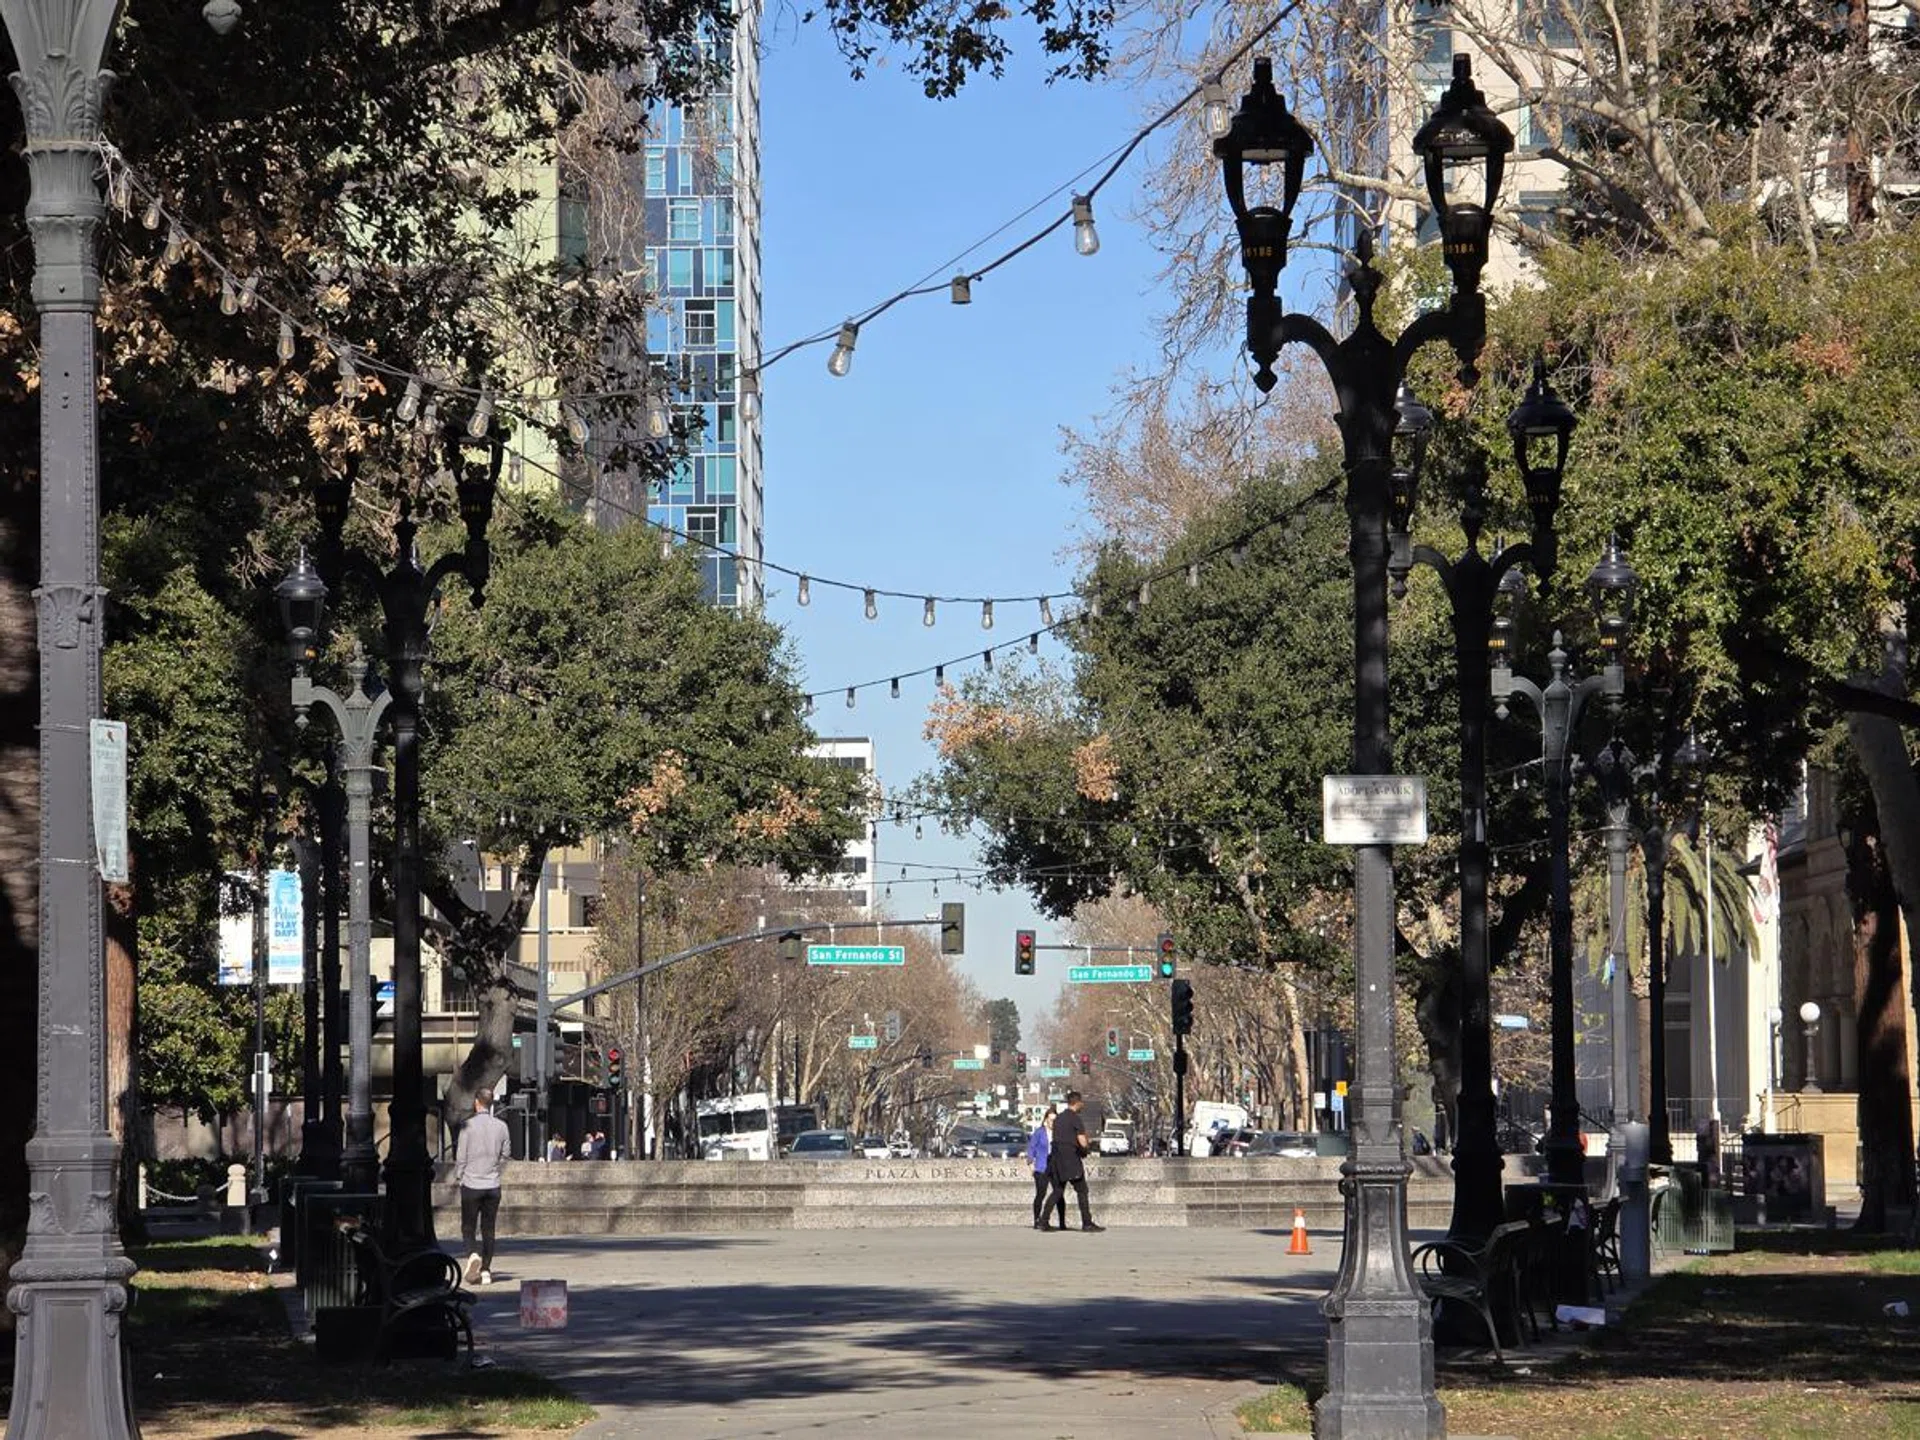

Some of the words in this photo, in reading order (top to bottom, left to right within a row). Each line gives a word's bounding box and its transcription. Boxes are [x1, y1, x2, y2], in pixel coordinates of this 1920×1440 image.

[274, 921, 297, 929] PLAY
[274, 929, 298, 937] DAYS
[811, 949, 832, 960] San
[835, 949, 885, 960] Fernando
[889, 949, 901, 960] St
[1071, 969, 1089, 979] San
[1091, 968, 1135, 979] Fernando
[1137, 967, 1149, 979] St
[865, 1168, 920, 1179] PLAZA
[931, 1168, 955, 1179] DE
